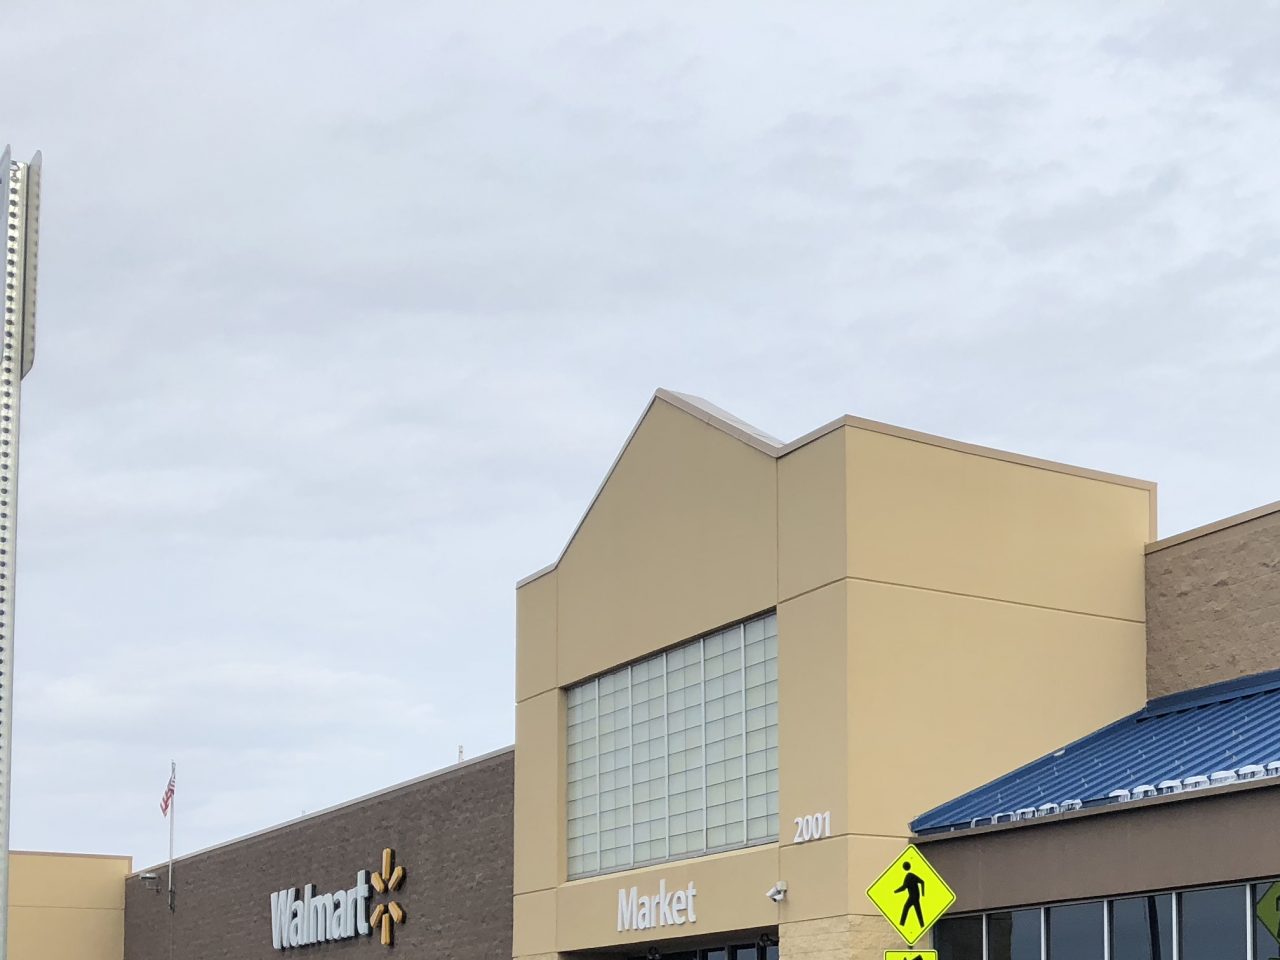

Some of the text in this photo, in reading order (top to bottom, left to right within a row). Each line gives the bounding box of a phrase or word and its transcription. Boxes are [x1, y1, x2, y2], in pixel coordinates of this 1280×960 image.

[793, 811, 832, 843] 2001
[270, 869, 370, 950] Walmart
[617, 878, 697, 932] Market
